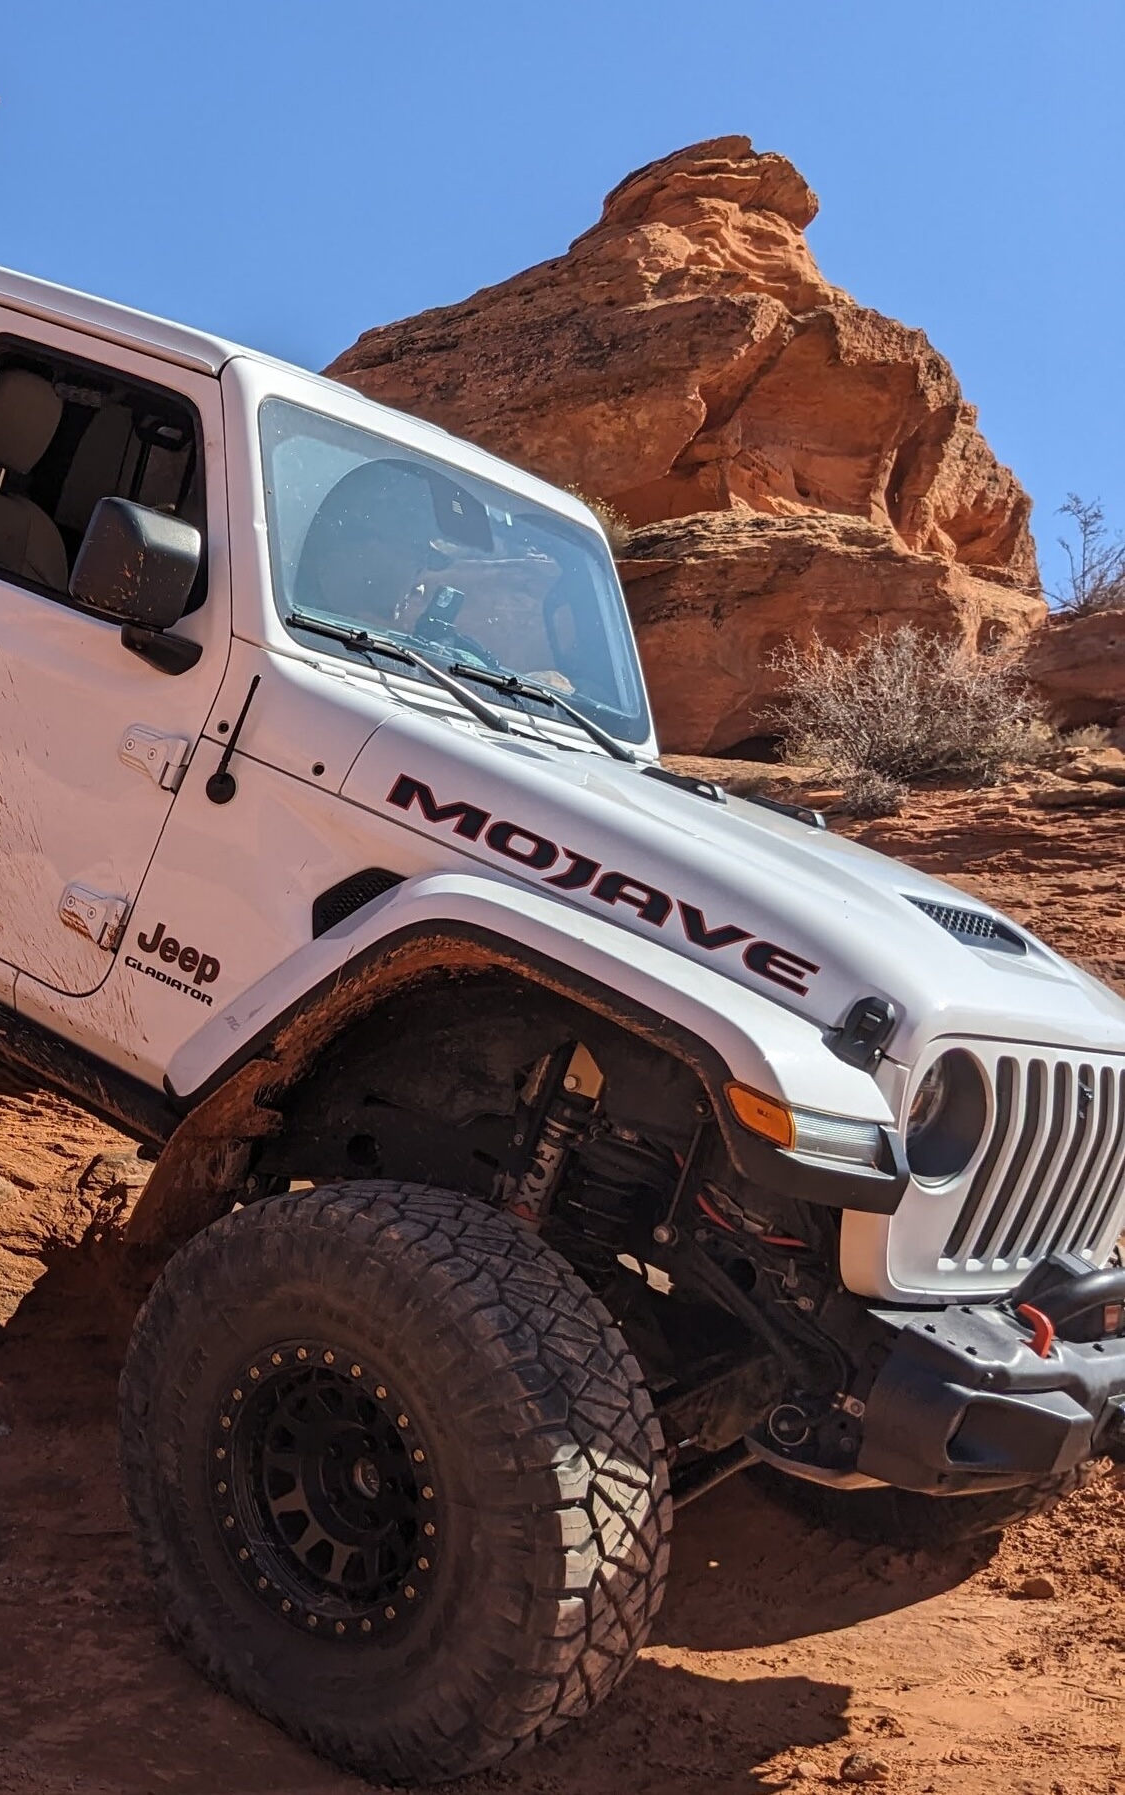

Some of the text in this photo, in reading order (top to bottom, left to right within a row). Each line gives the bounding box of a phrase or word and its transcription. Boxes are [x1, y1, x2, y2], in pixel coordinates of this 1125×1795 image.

[386, 773, 821, 997] MOJAVE
[125, 955, 213, 1006] GLADIATOR
[137, 922, 220, 984] Jeep
